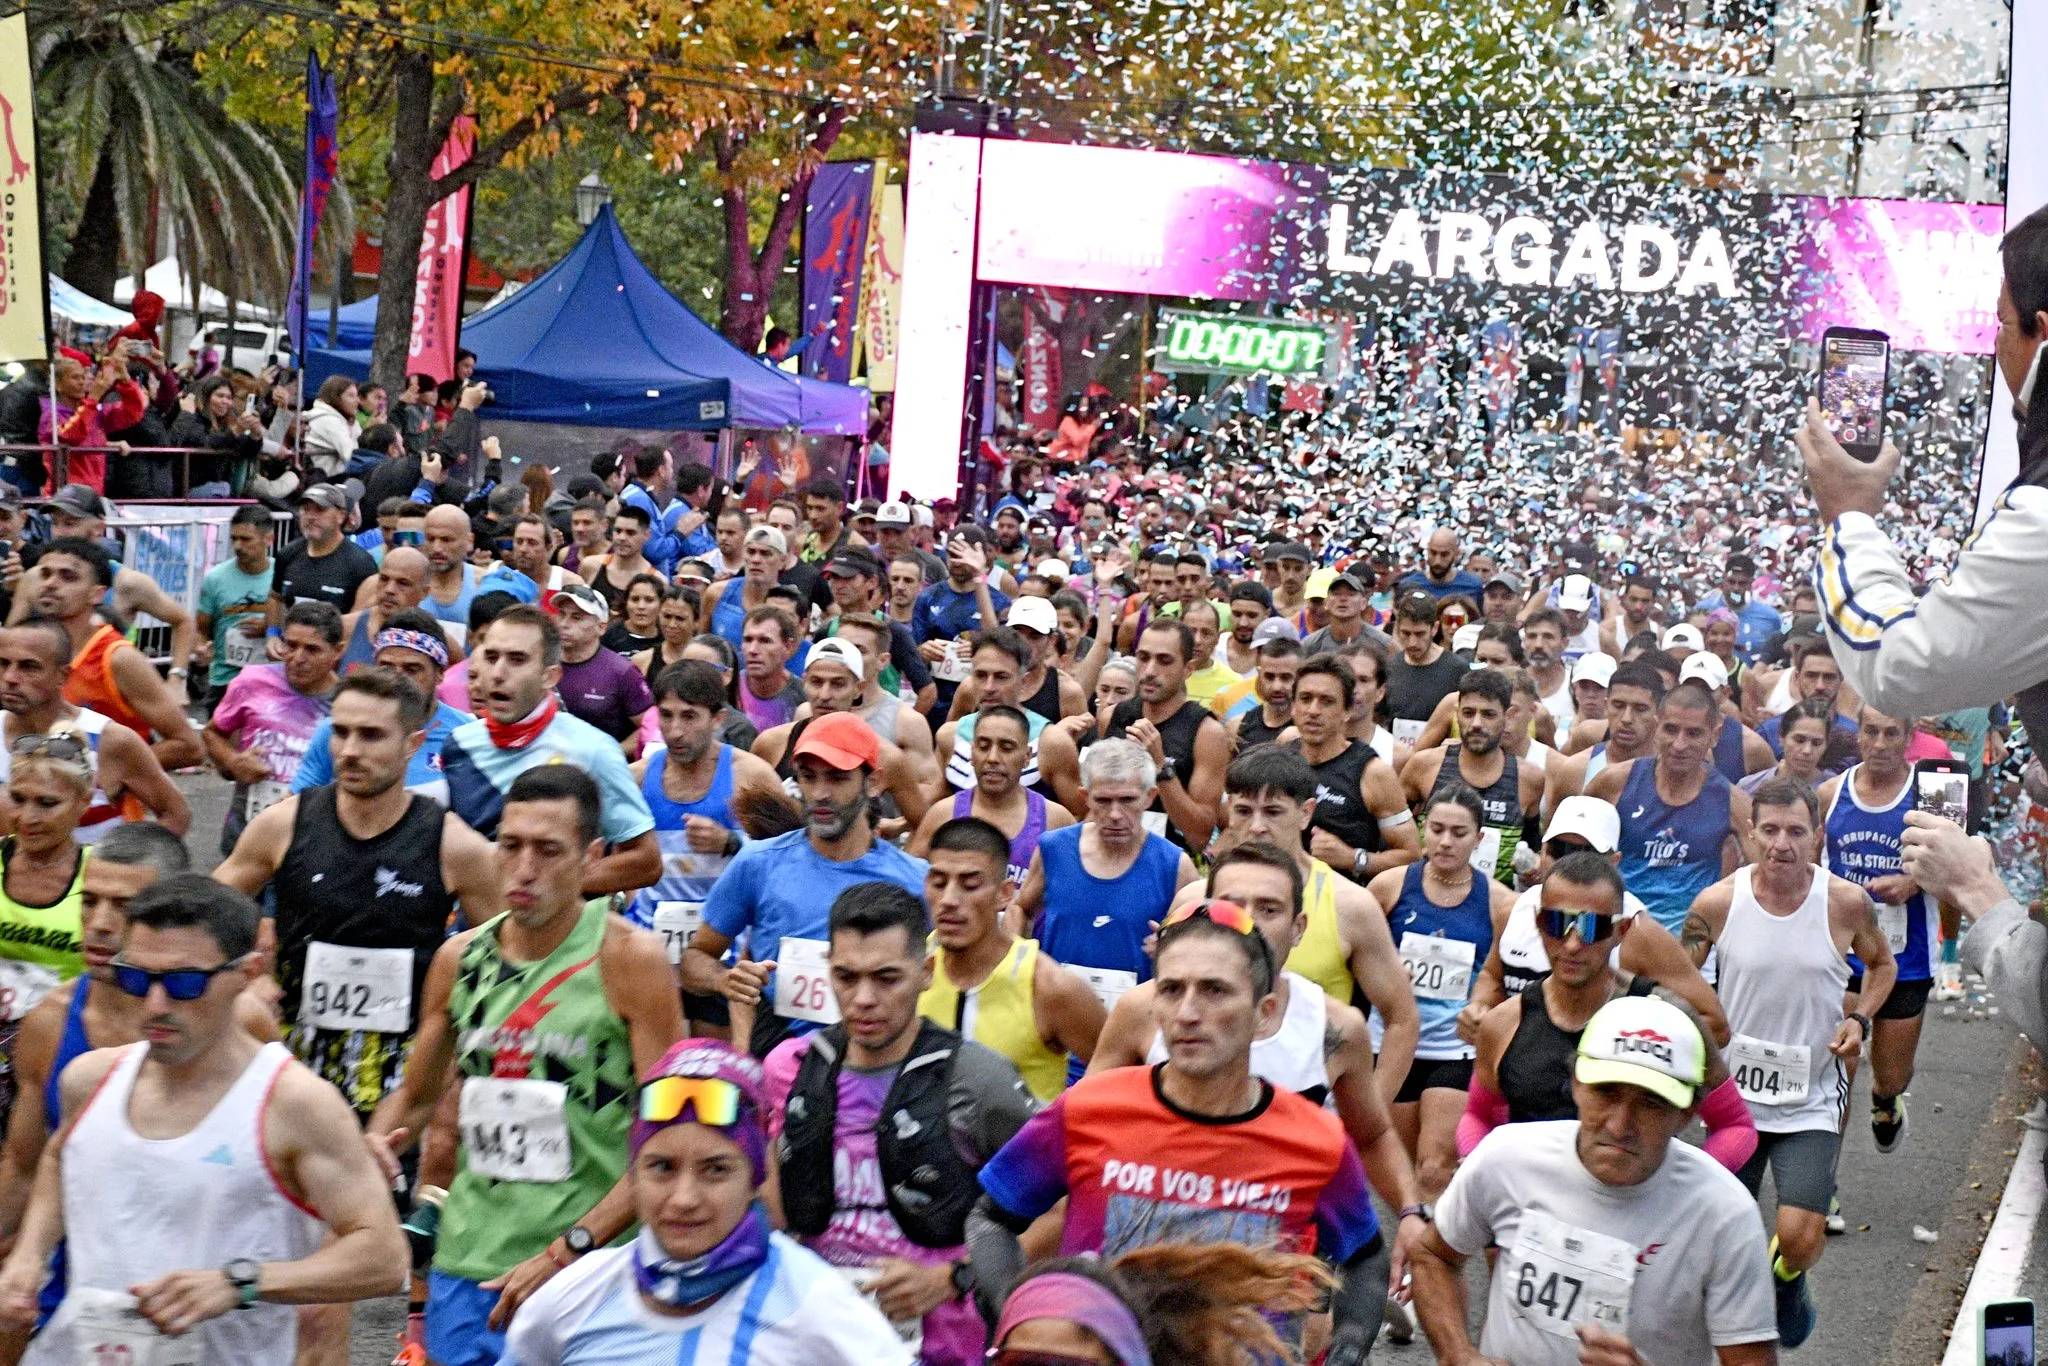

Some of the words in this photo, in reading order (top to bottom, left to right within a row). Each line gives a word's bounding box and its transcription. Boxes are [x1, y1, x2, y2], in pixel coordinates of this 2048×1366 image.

[1326, 203, 1741, 298] LARGADA
[1168, 319, 1322, 371] 00:00:07
[1481, 799, 1507, 814] LES
[1643, 839, 1690, 859] Tito's
[1864, 854, 1904, 870] STRIZZ
[310, 980, 372, 1018] 942
[790, 975, 828, 1011] 26
[1734, 1064, 1780, 1096] 404
[1786, 1080, 1804, 1093] 21K
[1101, 1158, 1158, 1195] POR
[1162, 1167, 1216, 1204] VOS
[1220, 1177, 1292, 1213] VIEJO
[1517, 1261, 1585, 1321] 647
